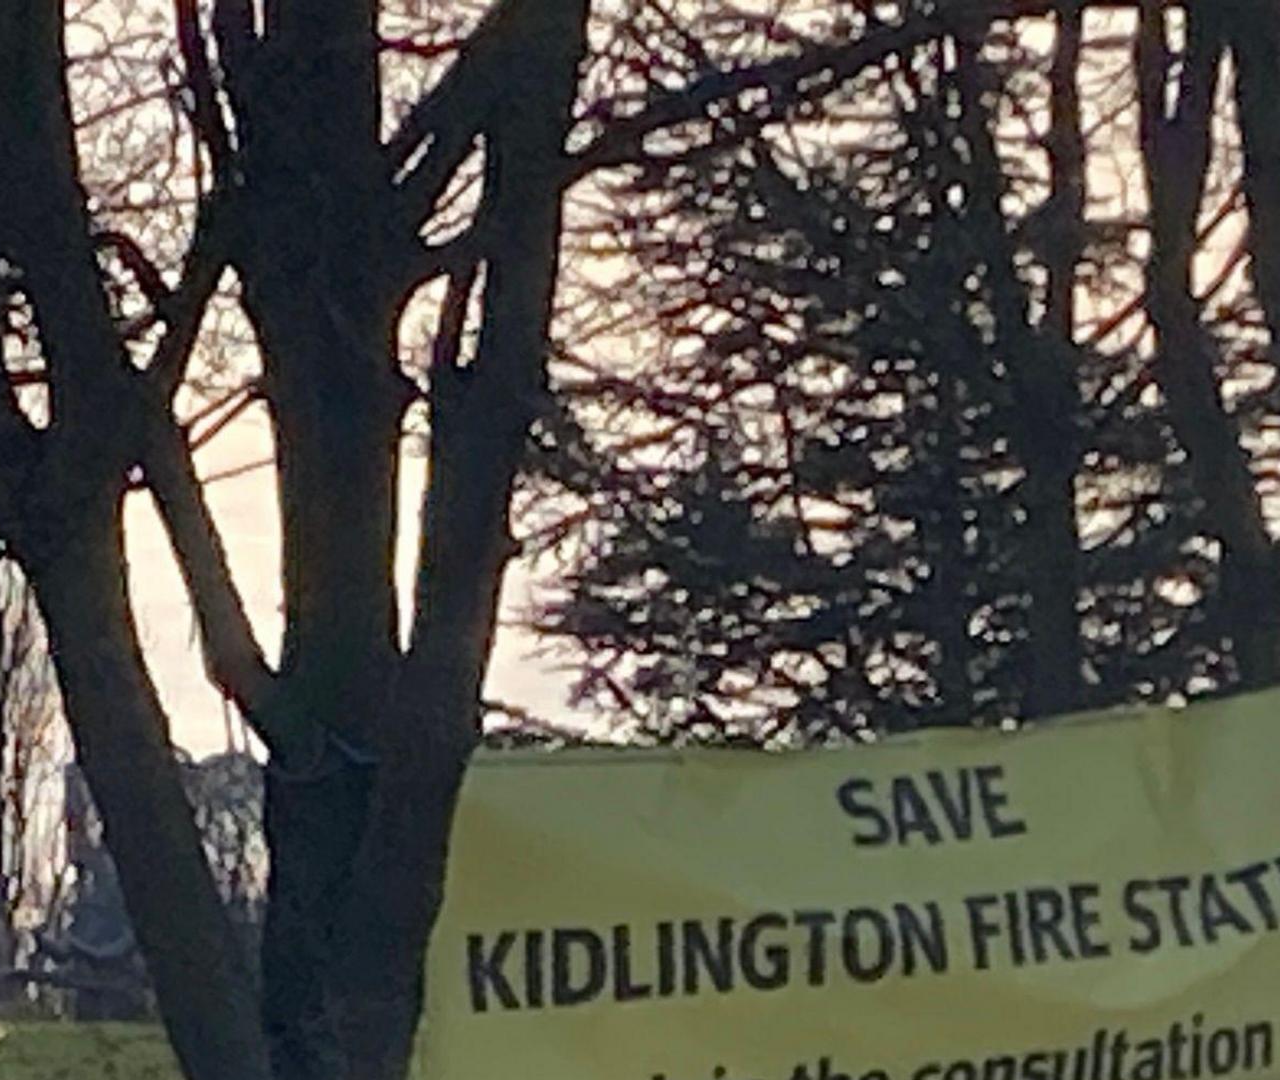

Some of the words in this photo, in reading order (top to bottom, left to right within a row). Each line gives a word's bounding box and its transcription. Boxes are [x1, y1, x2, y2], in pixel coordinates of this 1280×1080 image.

[836, 765, 1027, 849] SAVE
[465, 899, 949, 1013] KIDLINGTON
[967, 881, 1111, 971] FIRE
